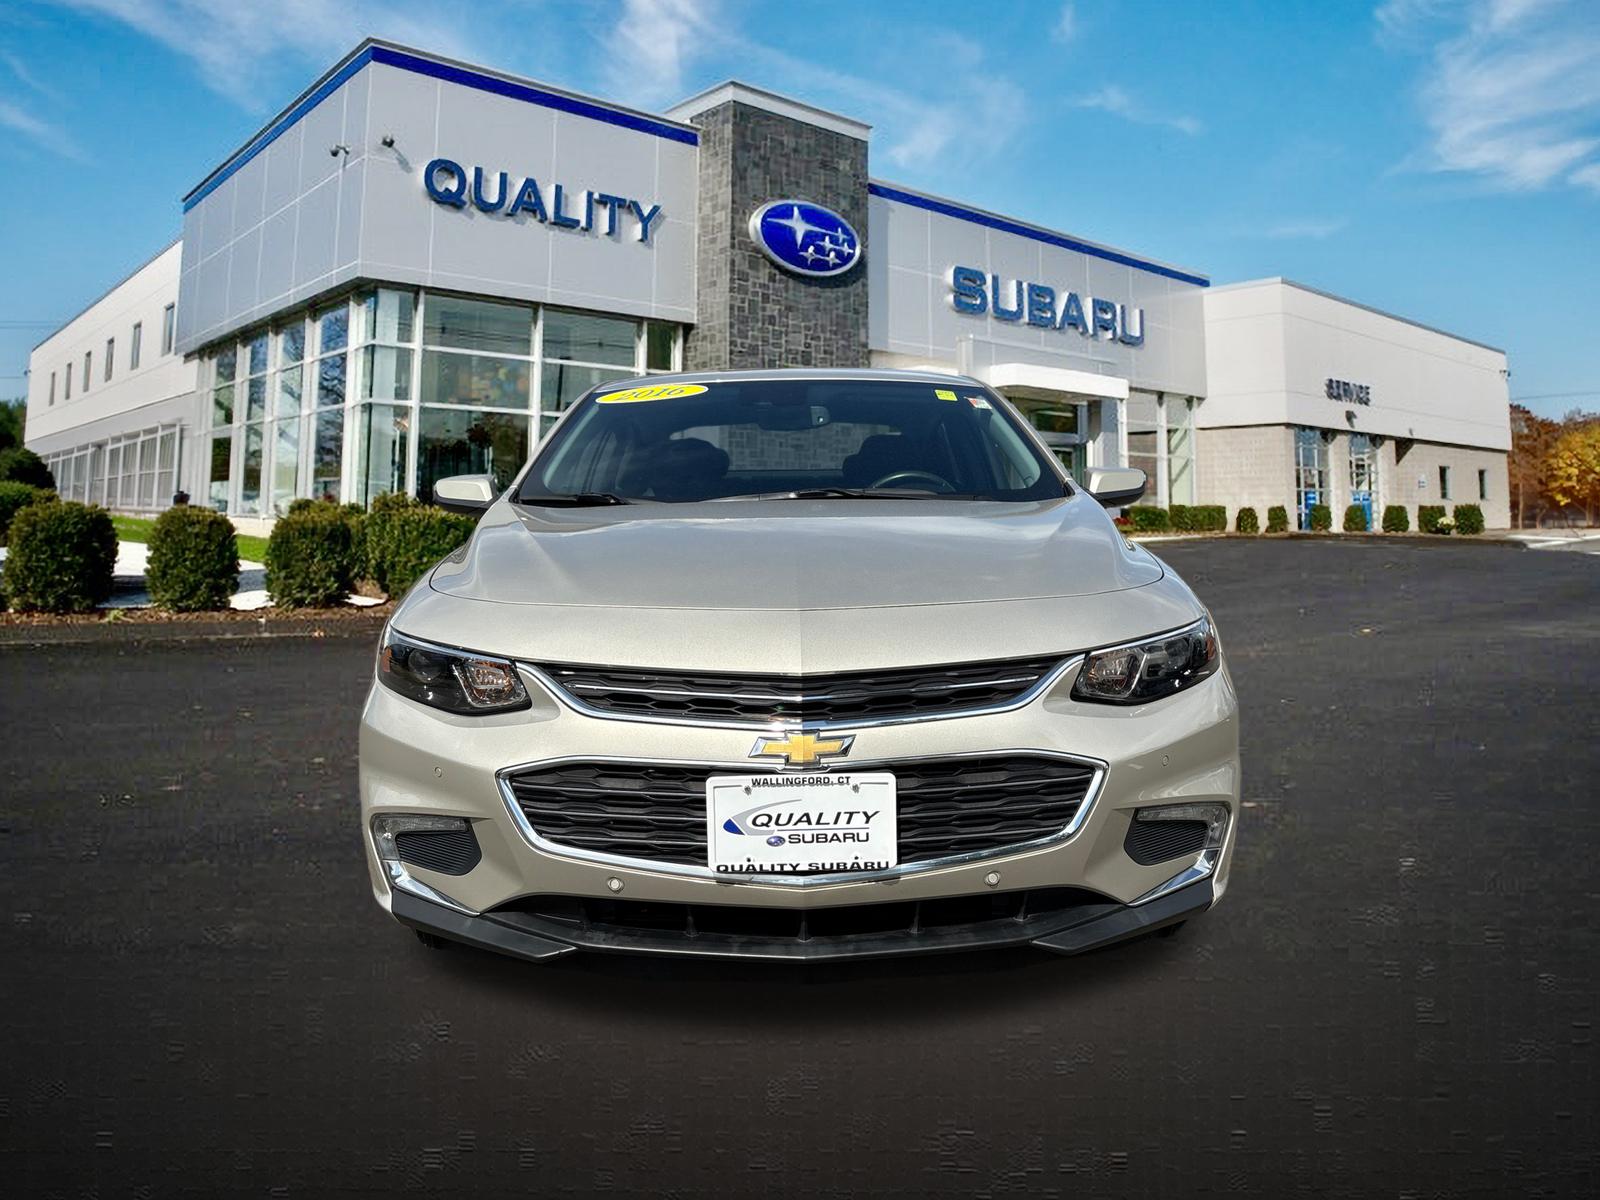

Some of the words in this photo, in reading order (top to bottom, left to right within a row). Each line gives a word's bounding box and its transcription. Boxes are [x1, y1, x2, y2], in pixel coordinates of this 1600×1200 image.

[424, 158, 661, 243] QUALITY
[950, 265, 1145, 346] SUBARU
[1325, 378, 1371, 406] SERVICE
[837, 776, 851, 785] CT
[751, 811, 880, 828] QUALITY
[788, 832, 869, 844] SUBARU
[716, 863, 799, 872] QUALITY
[808, 861, 889, 871] SUBARU
